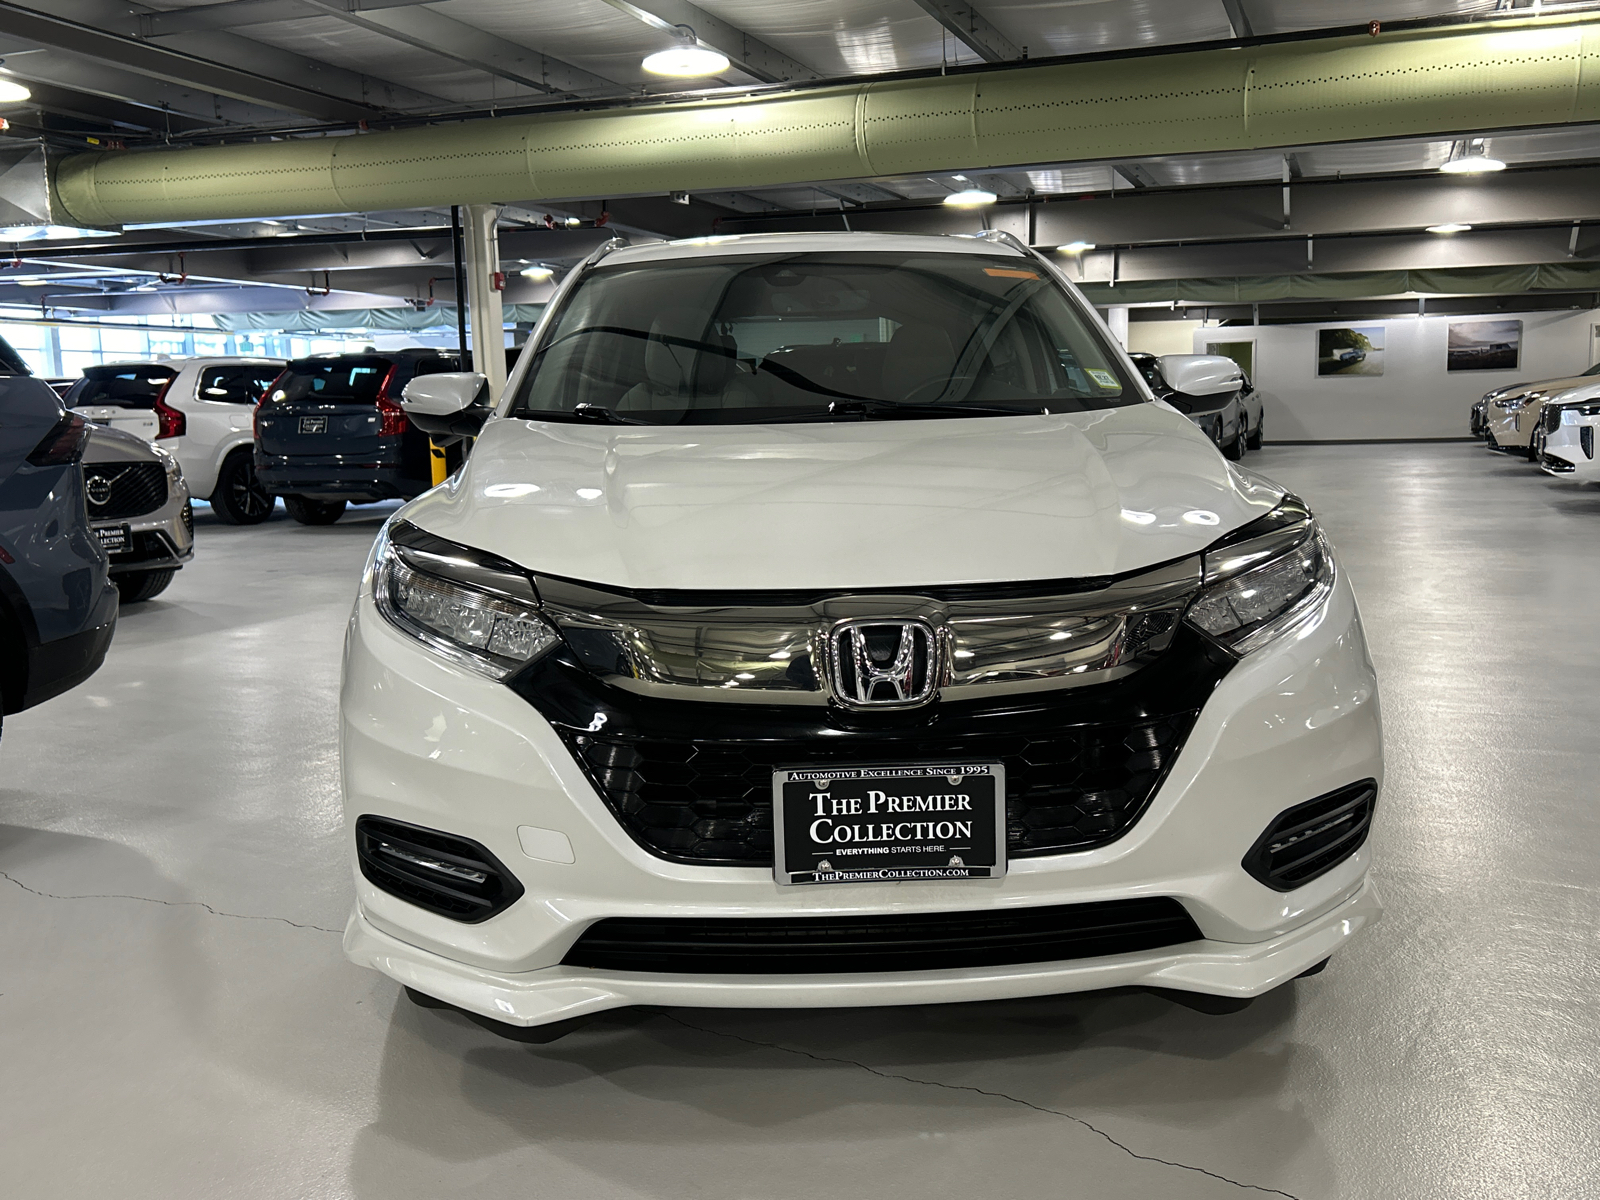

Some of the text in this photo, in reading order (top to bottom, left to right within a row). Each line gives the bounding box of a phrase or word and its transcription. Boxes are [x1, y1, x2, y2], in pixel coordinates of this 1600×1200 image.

[789, 765, 988, 781] AUTOMOTIVE EXCELLENCE SINCE 1995
[808, 790, 973, 816] THE PREMIER
[809, 818, 973, 844] COLLECTION
[835, 845, 947, 856] EVERYTHING STARTS HERE.
